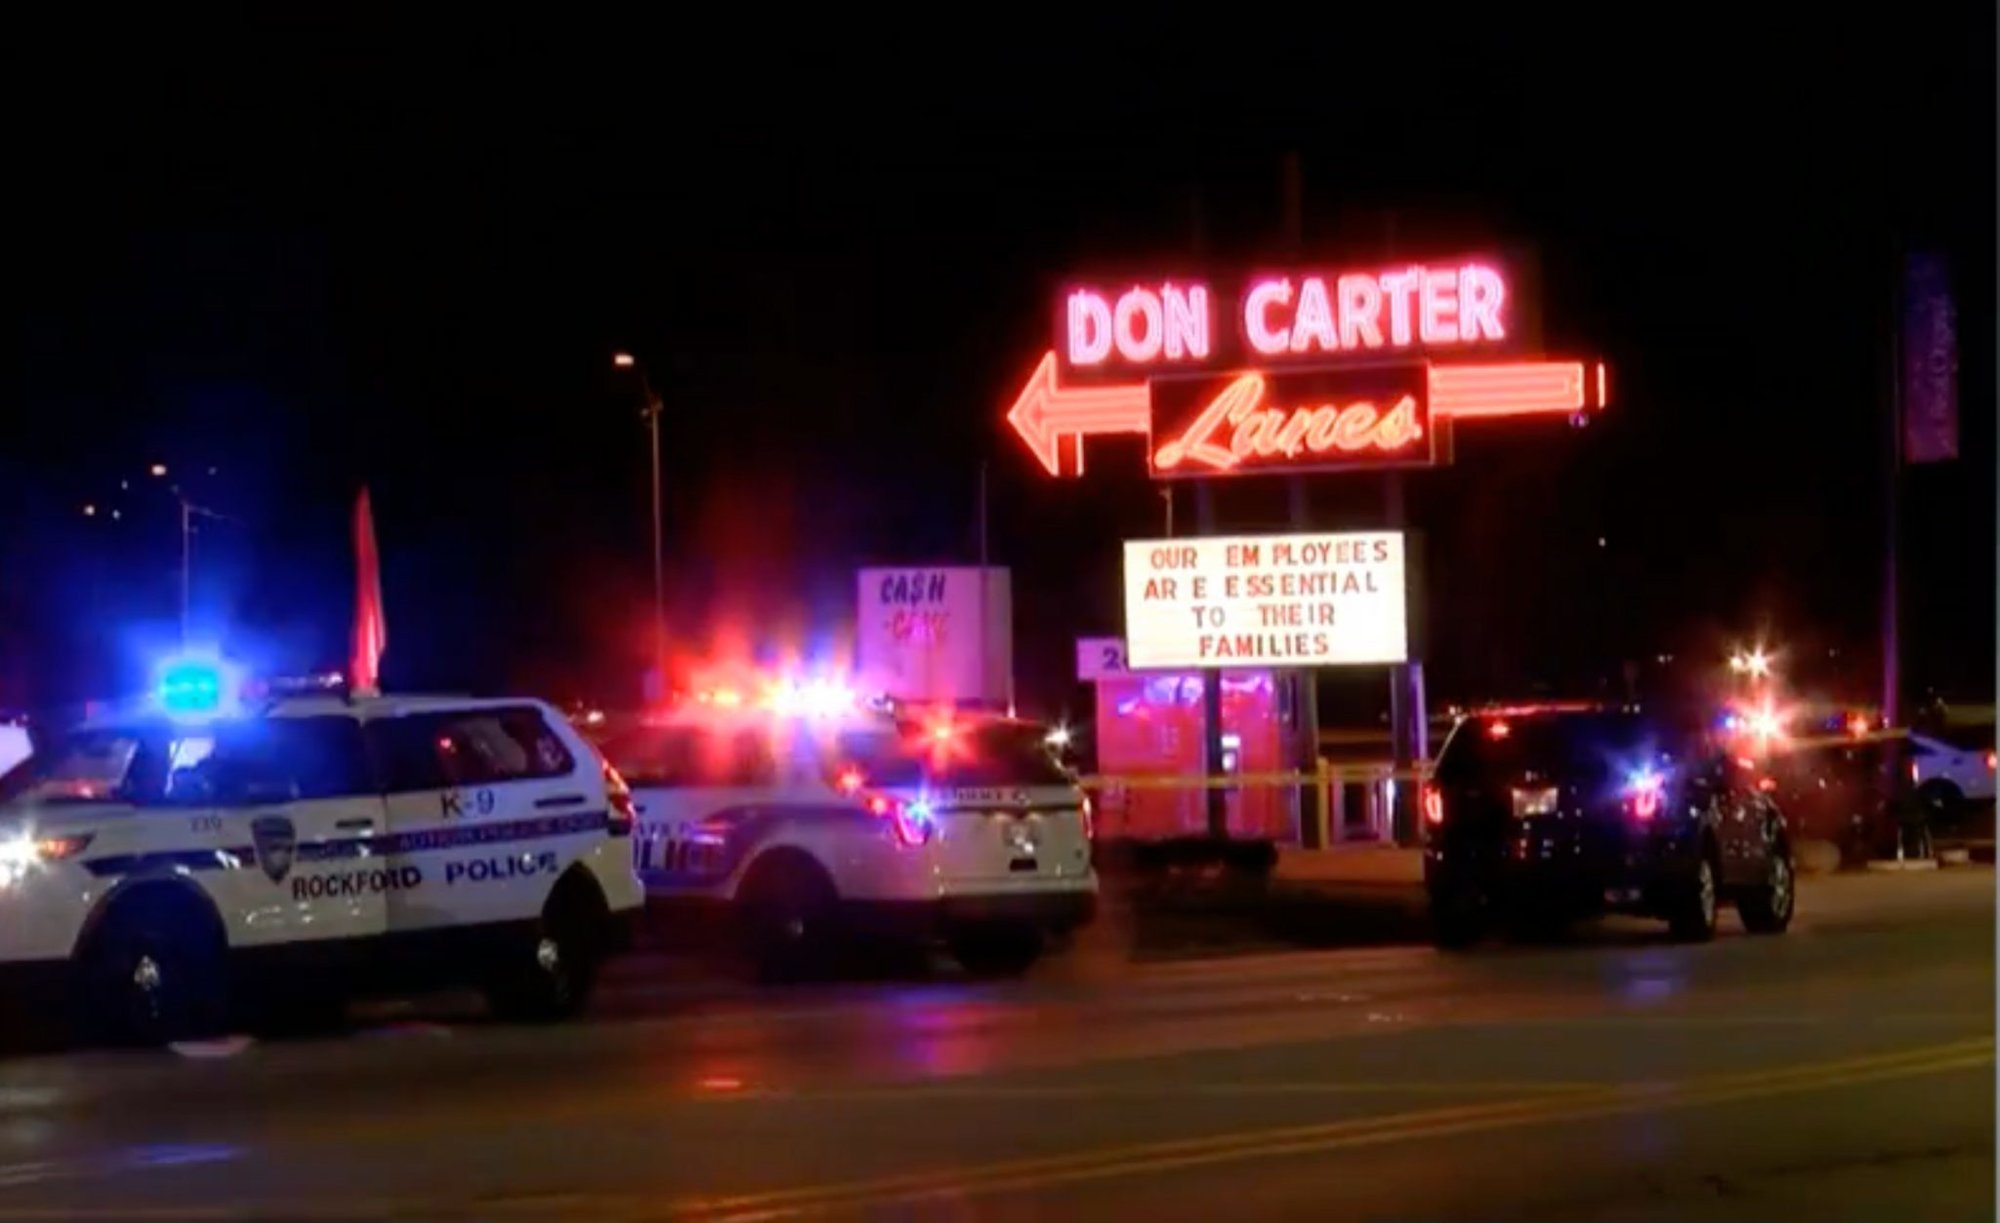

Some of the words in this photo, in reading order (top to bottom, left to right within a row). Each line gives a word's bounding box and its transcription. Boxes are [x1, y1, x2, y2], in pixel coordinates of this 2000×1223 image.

[1066, 283, 1209, 363] DON
[1244, 262, 1506, 354] CARTER
[1154, 370, 1423, 471] Lanes
[1150, 547, 1197, 570] OUR
[1225, 571, 1379, 598] ESSENTIAL
[1192, 605, 1226, 628] TO
[1258, 603, 1335, 627] THEIR
[1199, 633, 1329, 658] FAMILIES
[441, 788, 495, 818] K-9
[291, 865, 422, 900] ROCKFORD
[444, 852, 558, 885] POLICE
